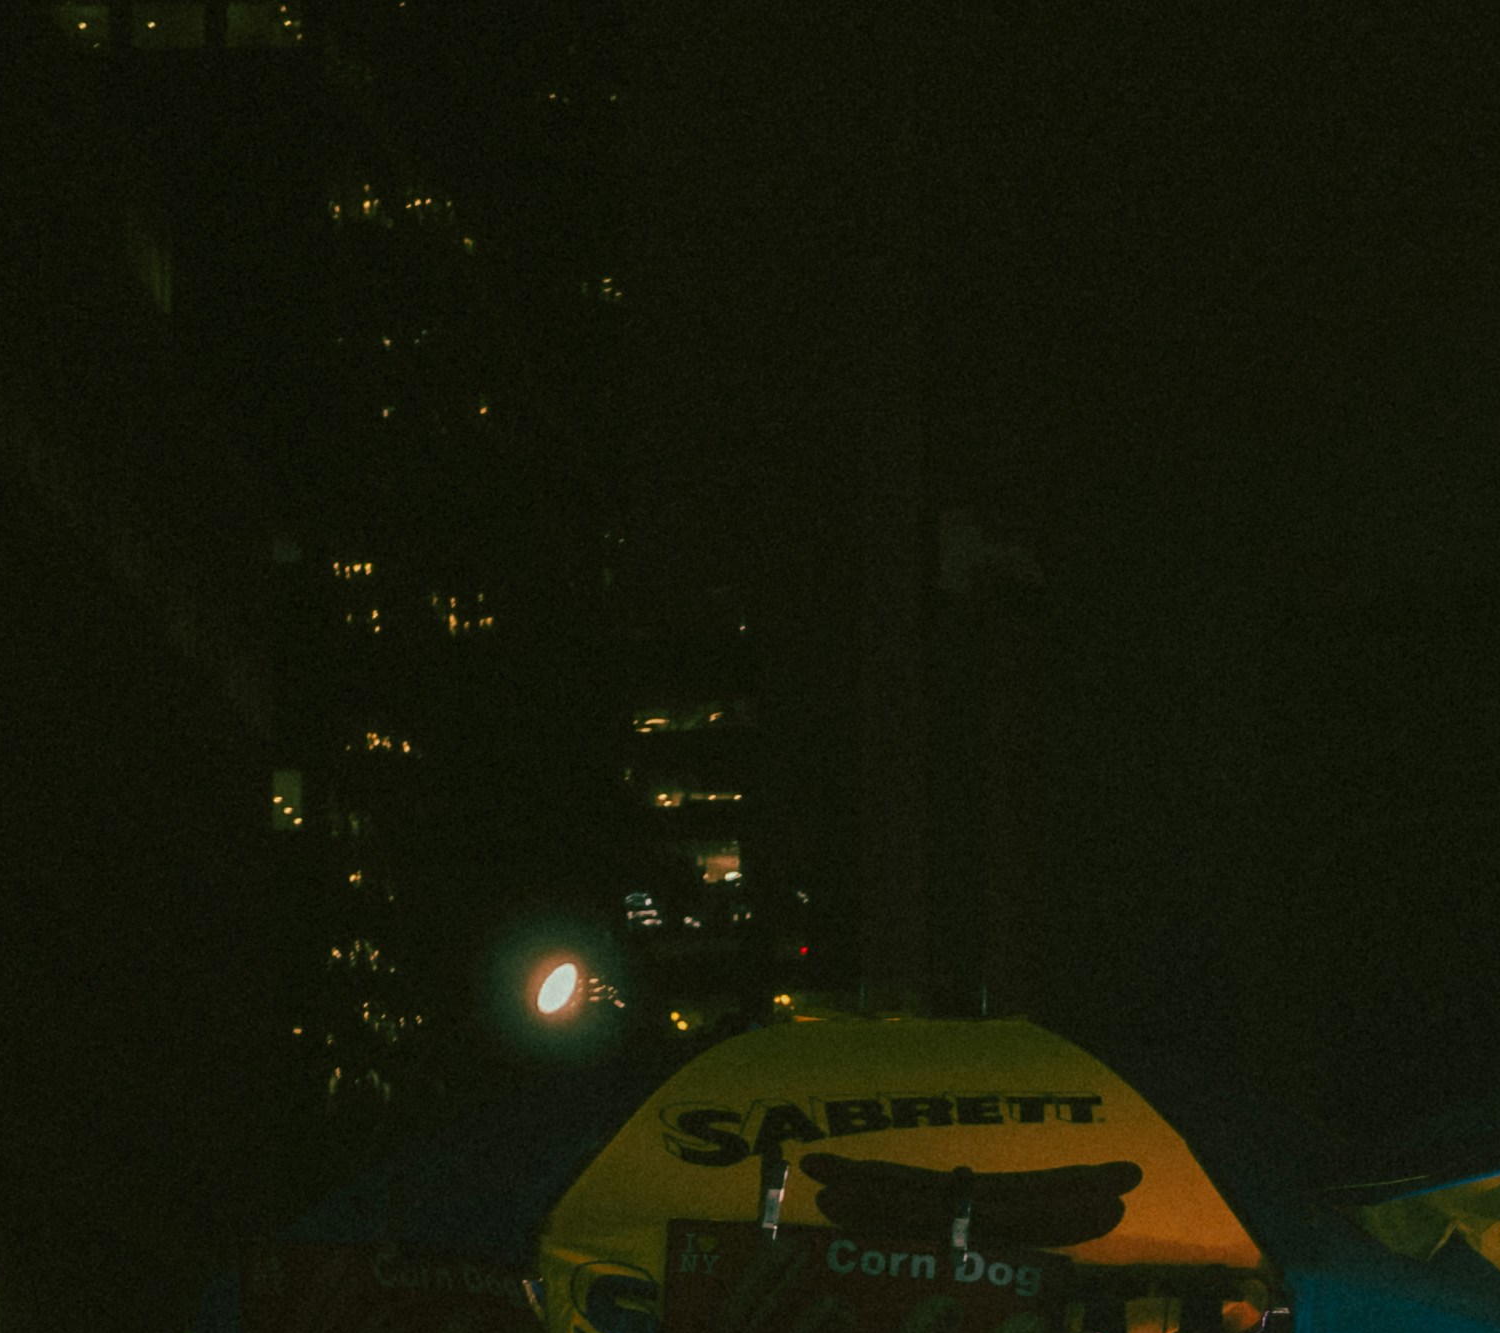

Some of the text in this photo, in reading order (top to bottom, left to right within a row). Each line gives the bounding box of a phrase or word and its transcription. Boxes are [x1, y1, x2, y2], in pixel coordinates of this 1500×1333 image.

[660, 1094, 1104, 1166] SABRETT
[825, 1237, 1042, 1297] Corn Dog
